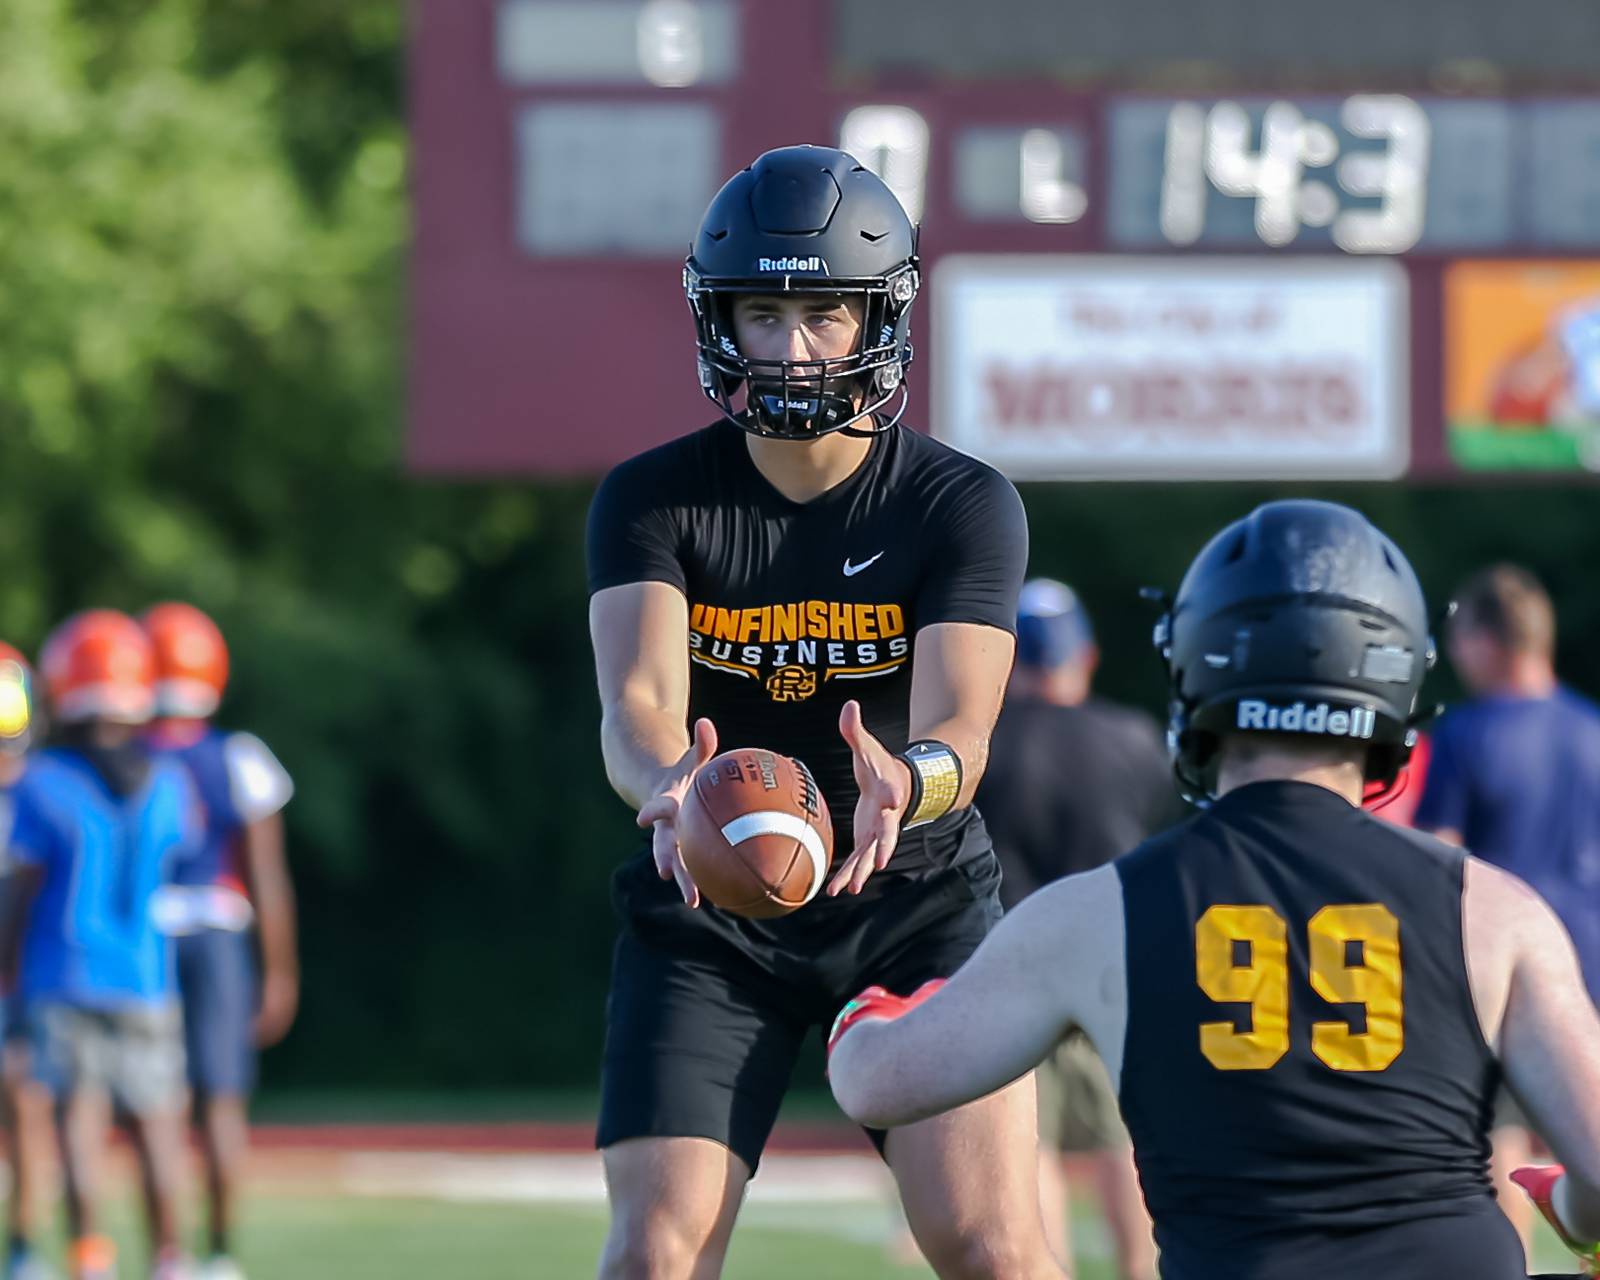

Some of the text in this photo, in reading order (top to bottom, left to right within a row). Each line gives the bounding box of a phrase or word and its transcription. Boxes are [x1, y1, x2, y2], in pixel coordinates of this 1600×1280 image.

[759, 257, 820, 271] Riddell
[778, 400, 808, 410] Rddell
[690, 600, 904, 643] UNFINISHED
[689, 631, 908, 666] BUSINESS
[1237, 700, 1376, 739] Riddell
[1195, 904, 1404, 1072] 99
